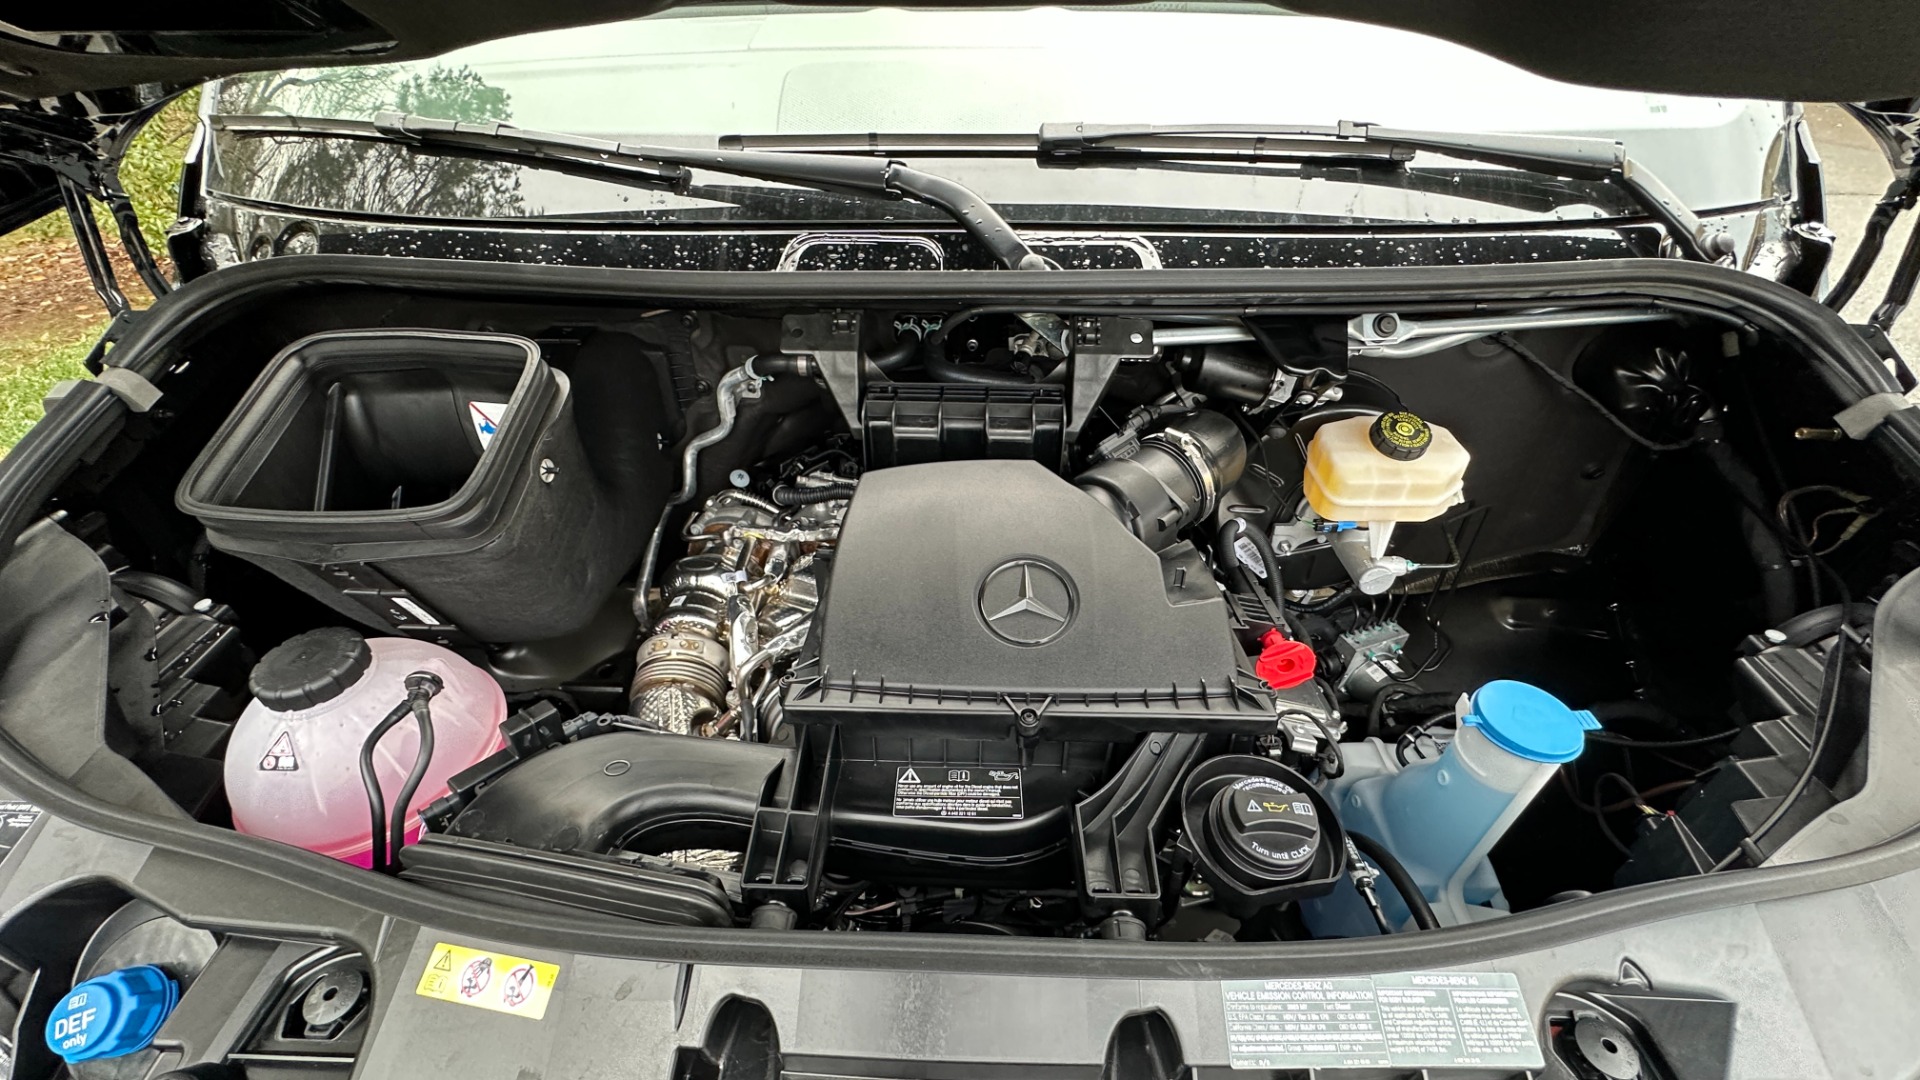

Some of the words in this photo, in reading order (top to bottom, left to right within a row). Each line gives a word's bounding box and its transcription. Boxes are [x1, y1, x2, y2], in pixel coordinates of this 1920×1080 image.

[1251, 841, 1270, 857] Turn
[1271, 851, 1290, 860] until
[1291, 844, 1312, 859] CLICK
[1264, 981, 1321, 990] MERCEDES-BENZ
[1322, 981, 1333, 990] AG
[1226, 991, 1255, 1001] VEHICLE
[1256, 991, 1291, 1000] EMISSION
[1292, 991, 1325, 1000] CONTROL
[1326, 991, 1373, 1000] INFORMATION
[55, 1008, 96, 1040] DEF
[62, 1034, 88, 1048] only
